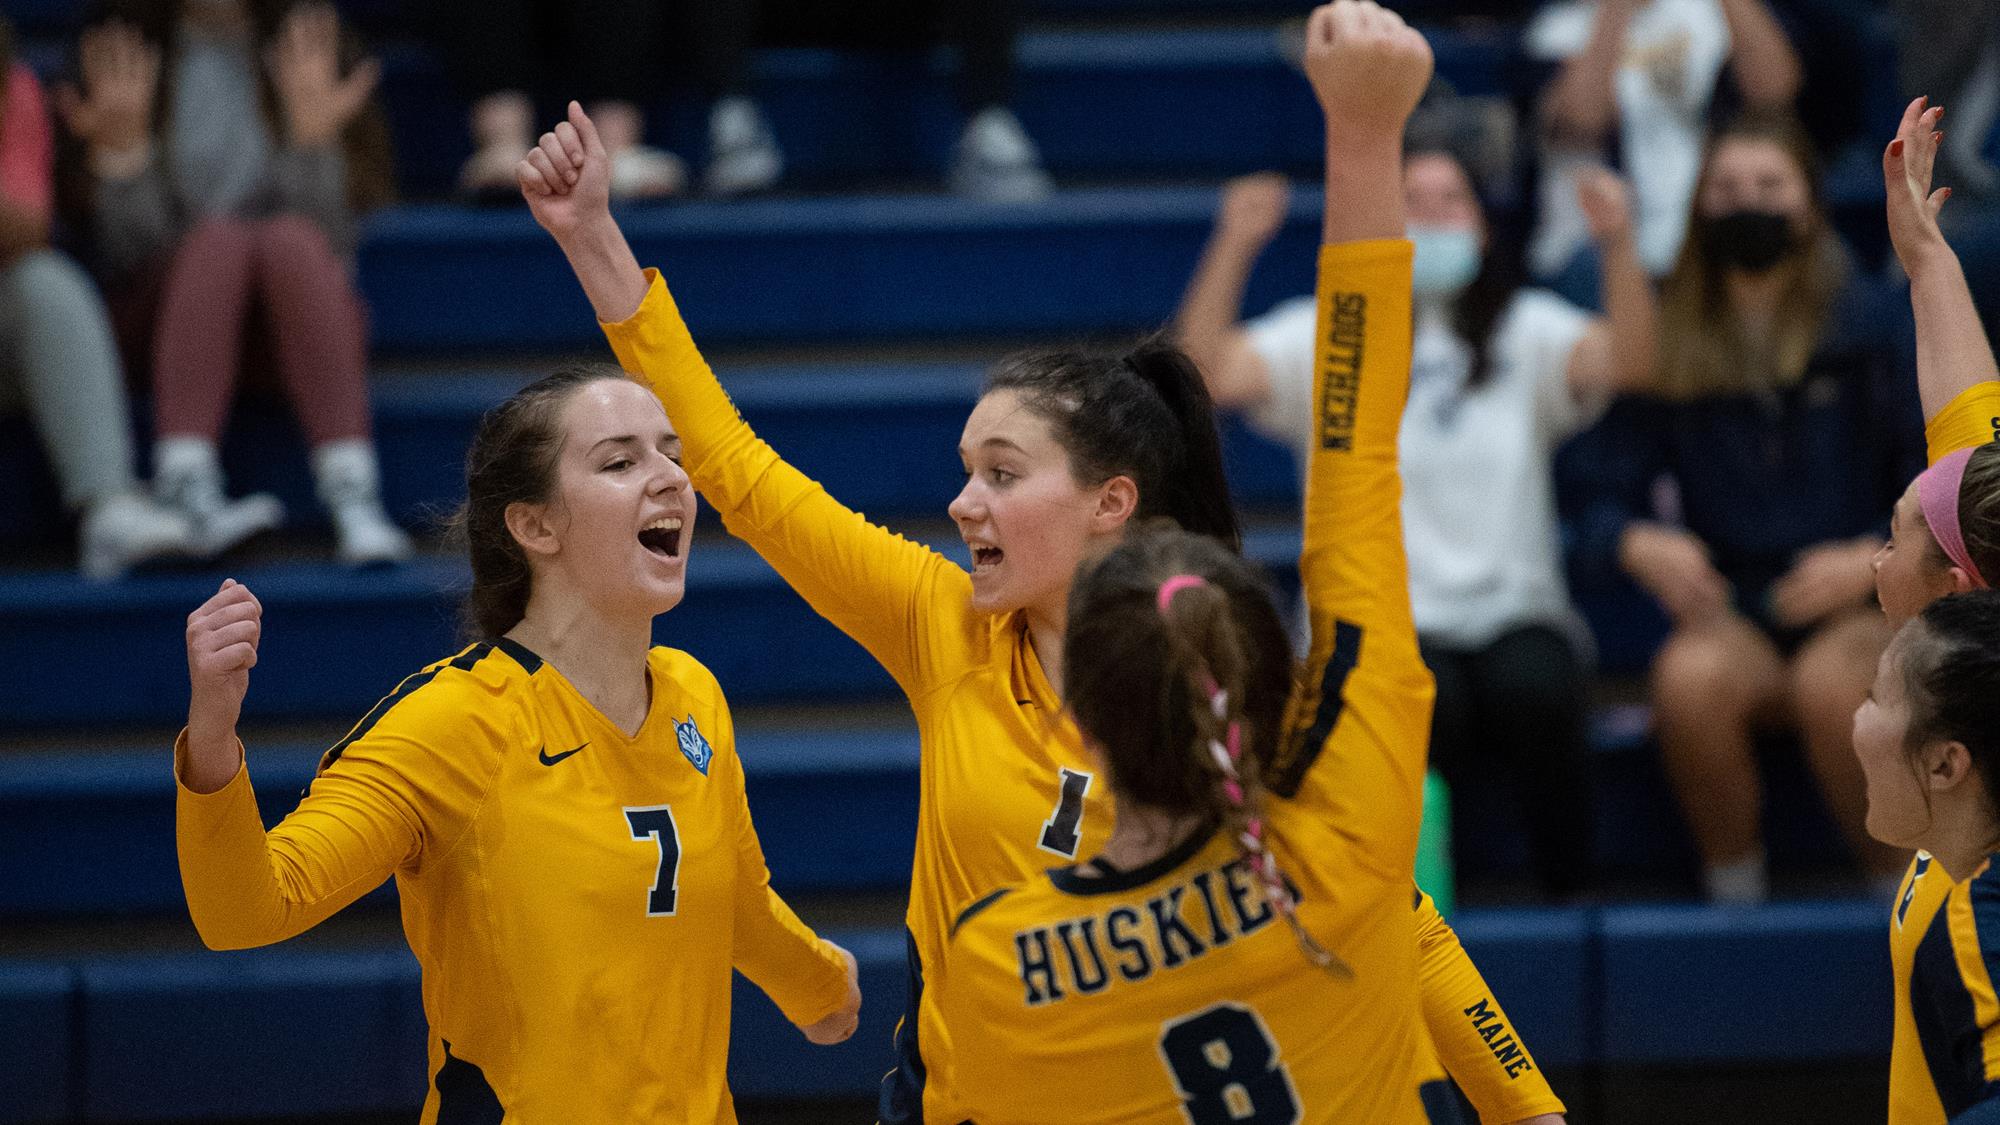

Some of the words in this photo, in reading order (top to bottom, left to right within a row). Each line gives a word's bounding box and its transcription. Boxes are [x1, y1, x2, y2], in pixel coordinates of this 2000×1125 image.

[622, 804, 682, 917] 7
[1036, 766, 1093, 860] 1
[1157, 1000, 1304, 1125] 8
[1464, 998, 1532, 1080] MAINE
